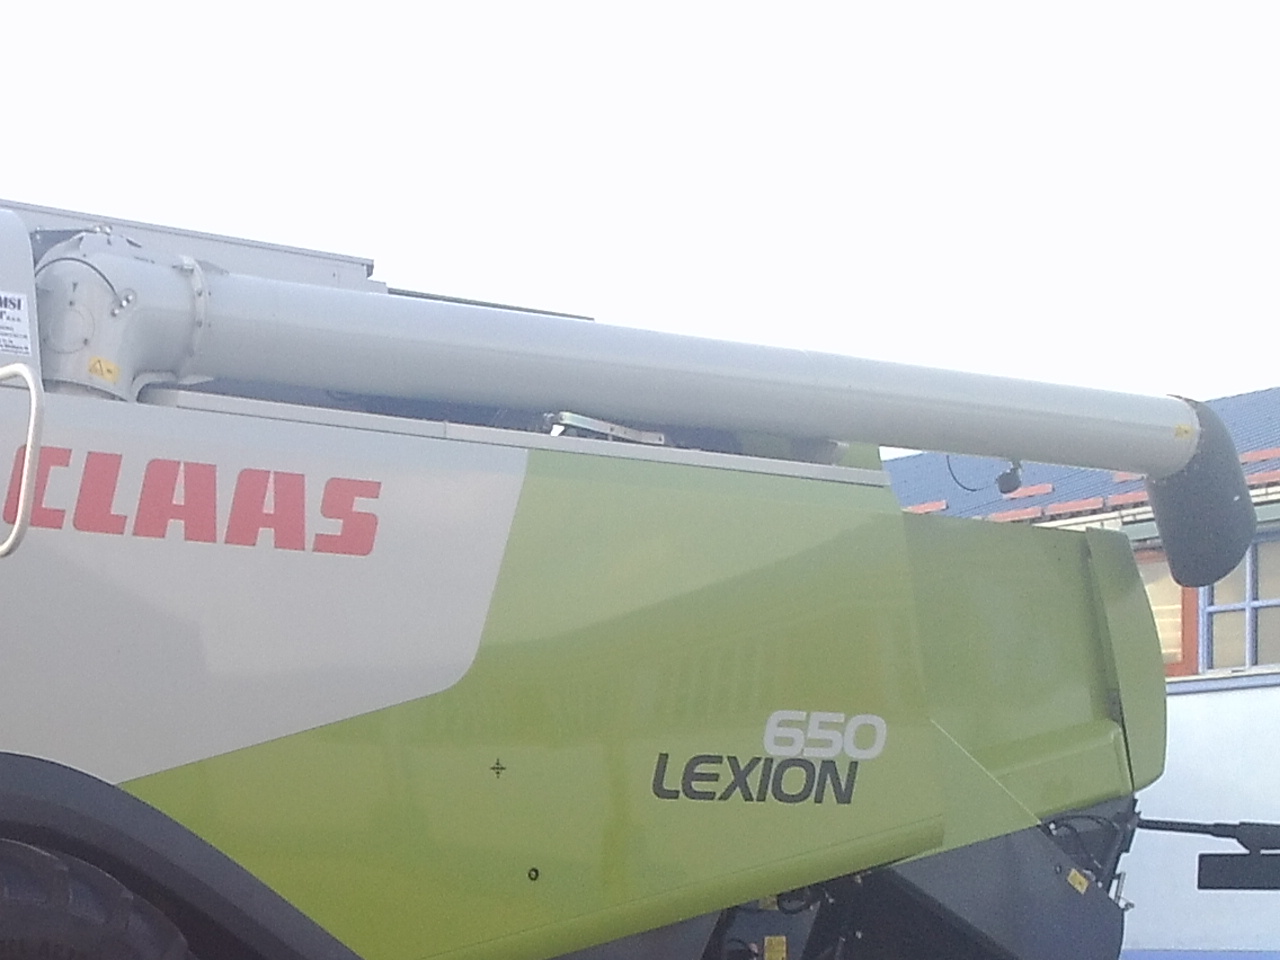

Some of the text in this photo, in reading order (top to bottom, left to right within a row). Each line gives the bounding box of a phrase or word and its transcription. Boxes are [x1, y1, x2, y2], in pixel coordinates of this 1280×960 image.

[2, 444, 382, 556] CLAAS
[763, 710, 887, 760] 650
[652, 753, 859, 804] LEXION
